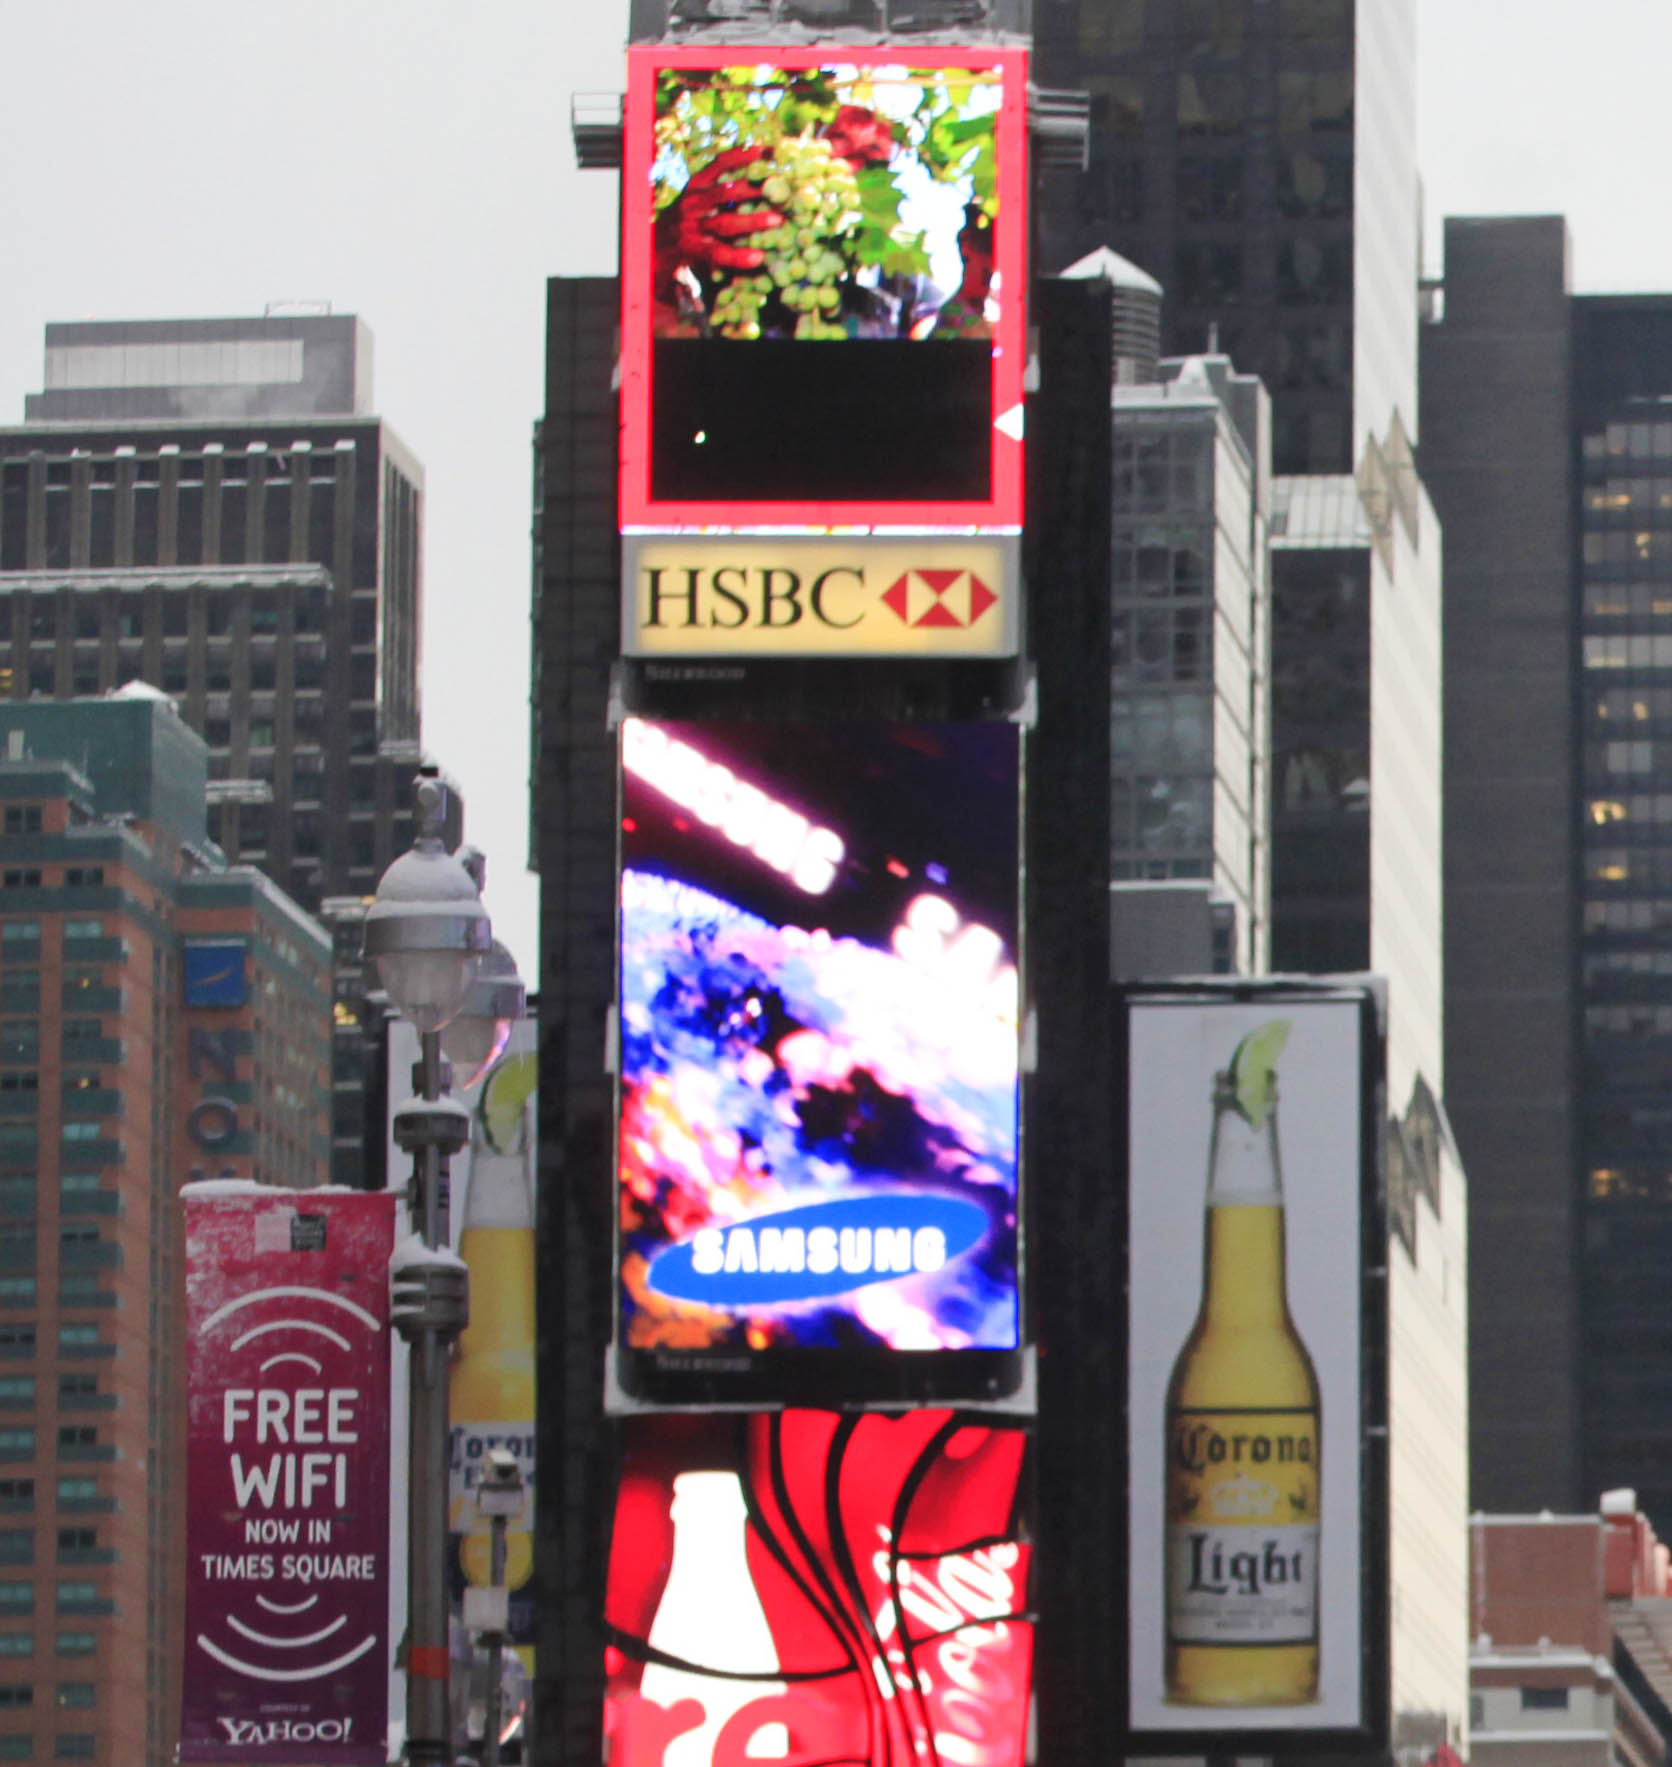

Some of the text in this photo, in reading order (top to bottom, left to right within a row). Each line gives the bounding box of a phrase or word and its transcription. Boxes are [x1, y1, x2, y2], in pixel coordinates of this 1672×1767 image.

[640, 565, 867, 629] HSBC
[692, 1225, 946, 1275] SAMSUNG
[223, 1388, 360, 1444] FREE
[229, 1453, 347, 1509] WIFI
[245, 1518, 332, 1545] NOW IN
[201, 1555, 376, 1583] TIMES SQUARE
[1186, 1530, 1304, 1597] Light
[217, 1716, 353, 1745] YAHOO!
